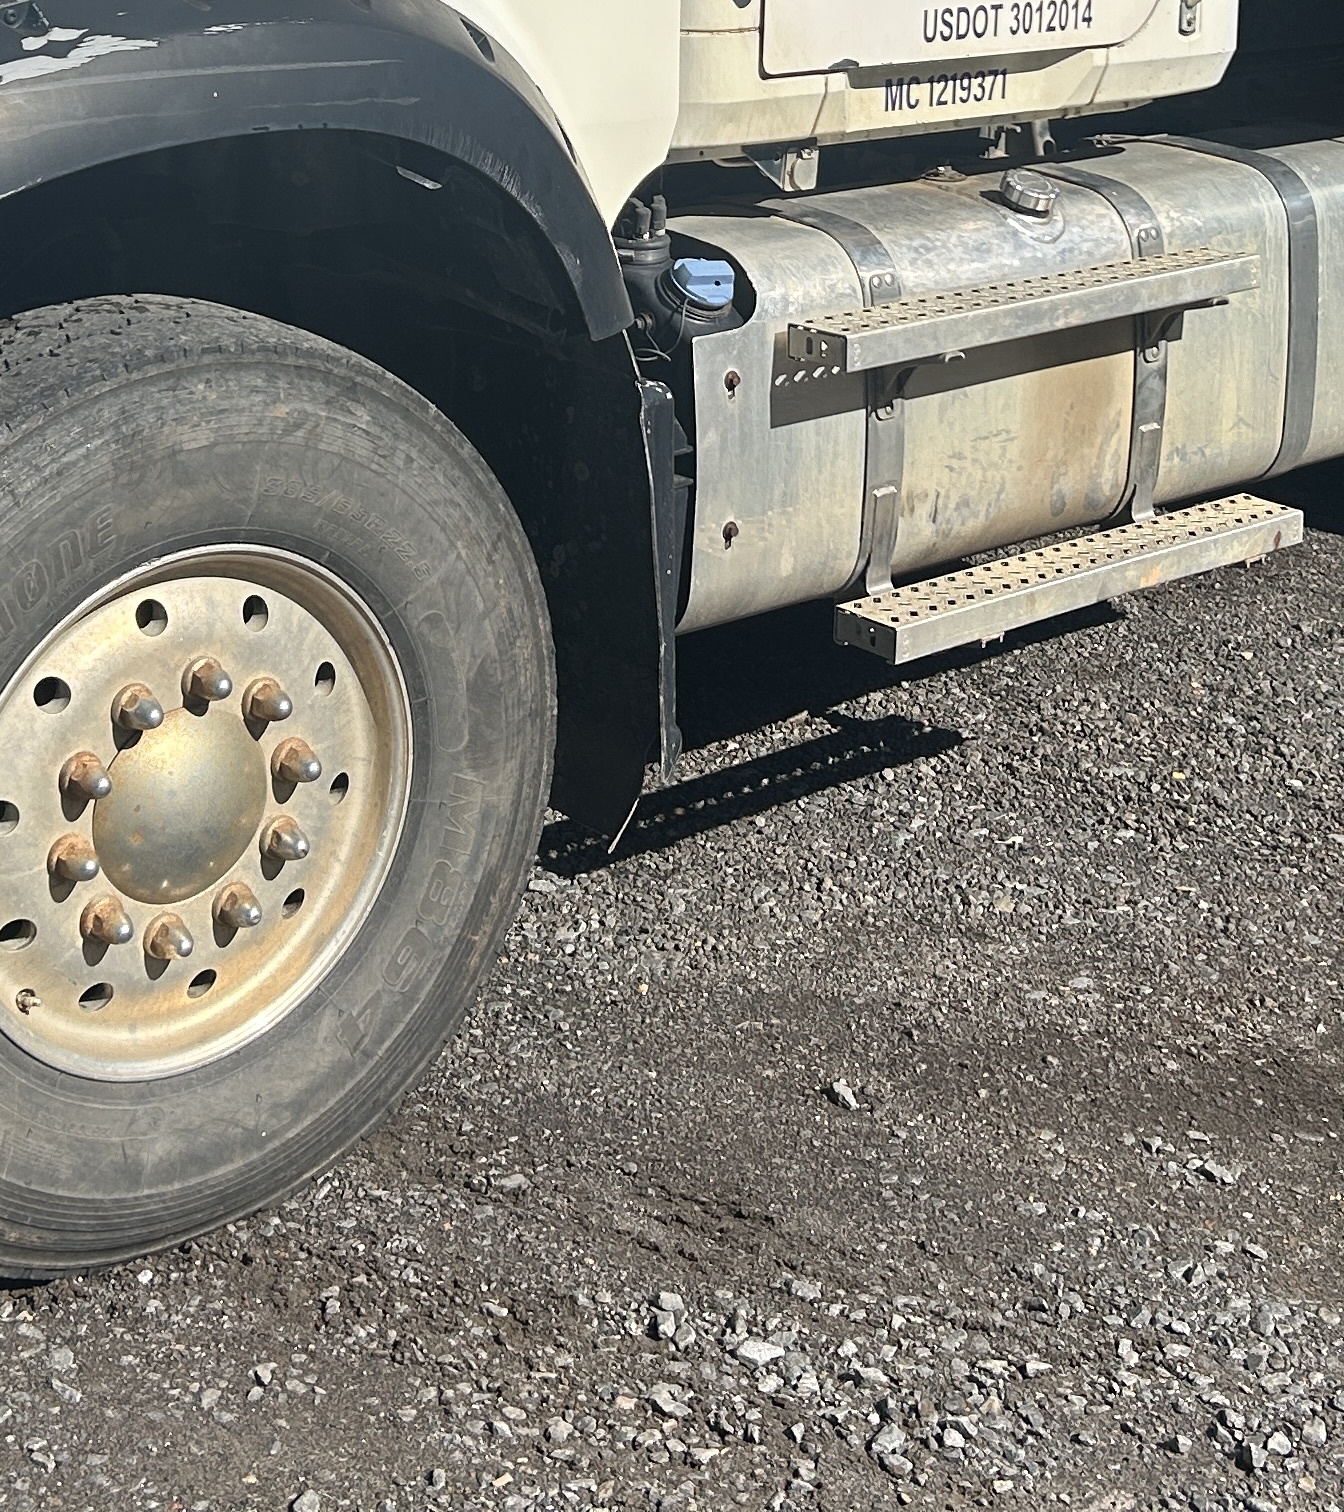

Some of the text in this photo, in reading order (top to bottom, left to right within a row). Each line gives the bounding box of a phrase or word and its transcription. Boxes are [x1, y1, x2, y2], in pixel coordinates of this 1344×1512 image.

[923, 3, 1003, 43] USDOT
[884, 68, 1008, 112] MC 1219371
